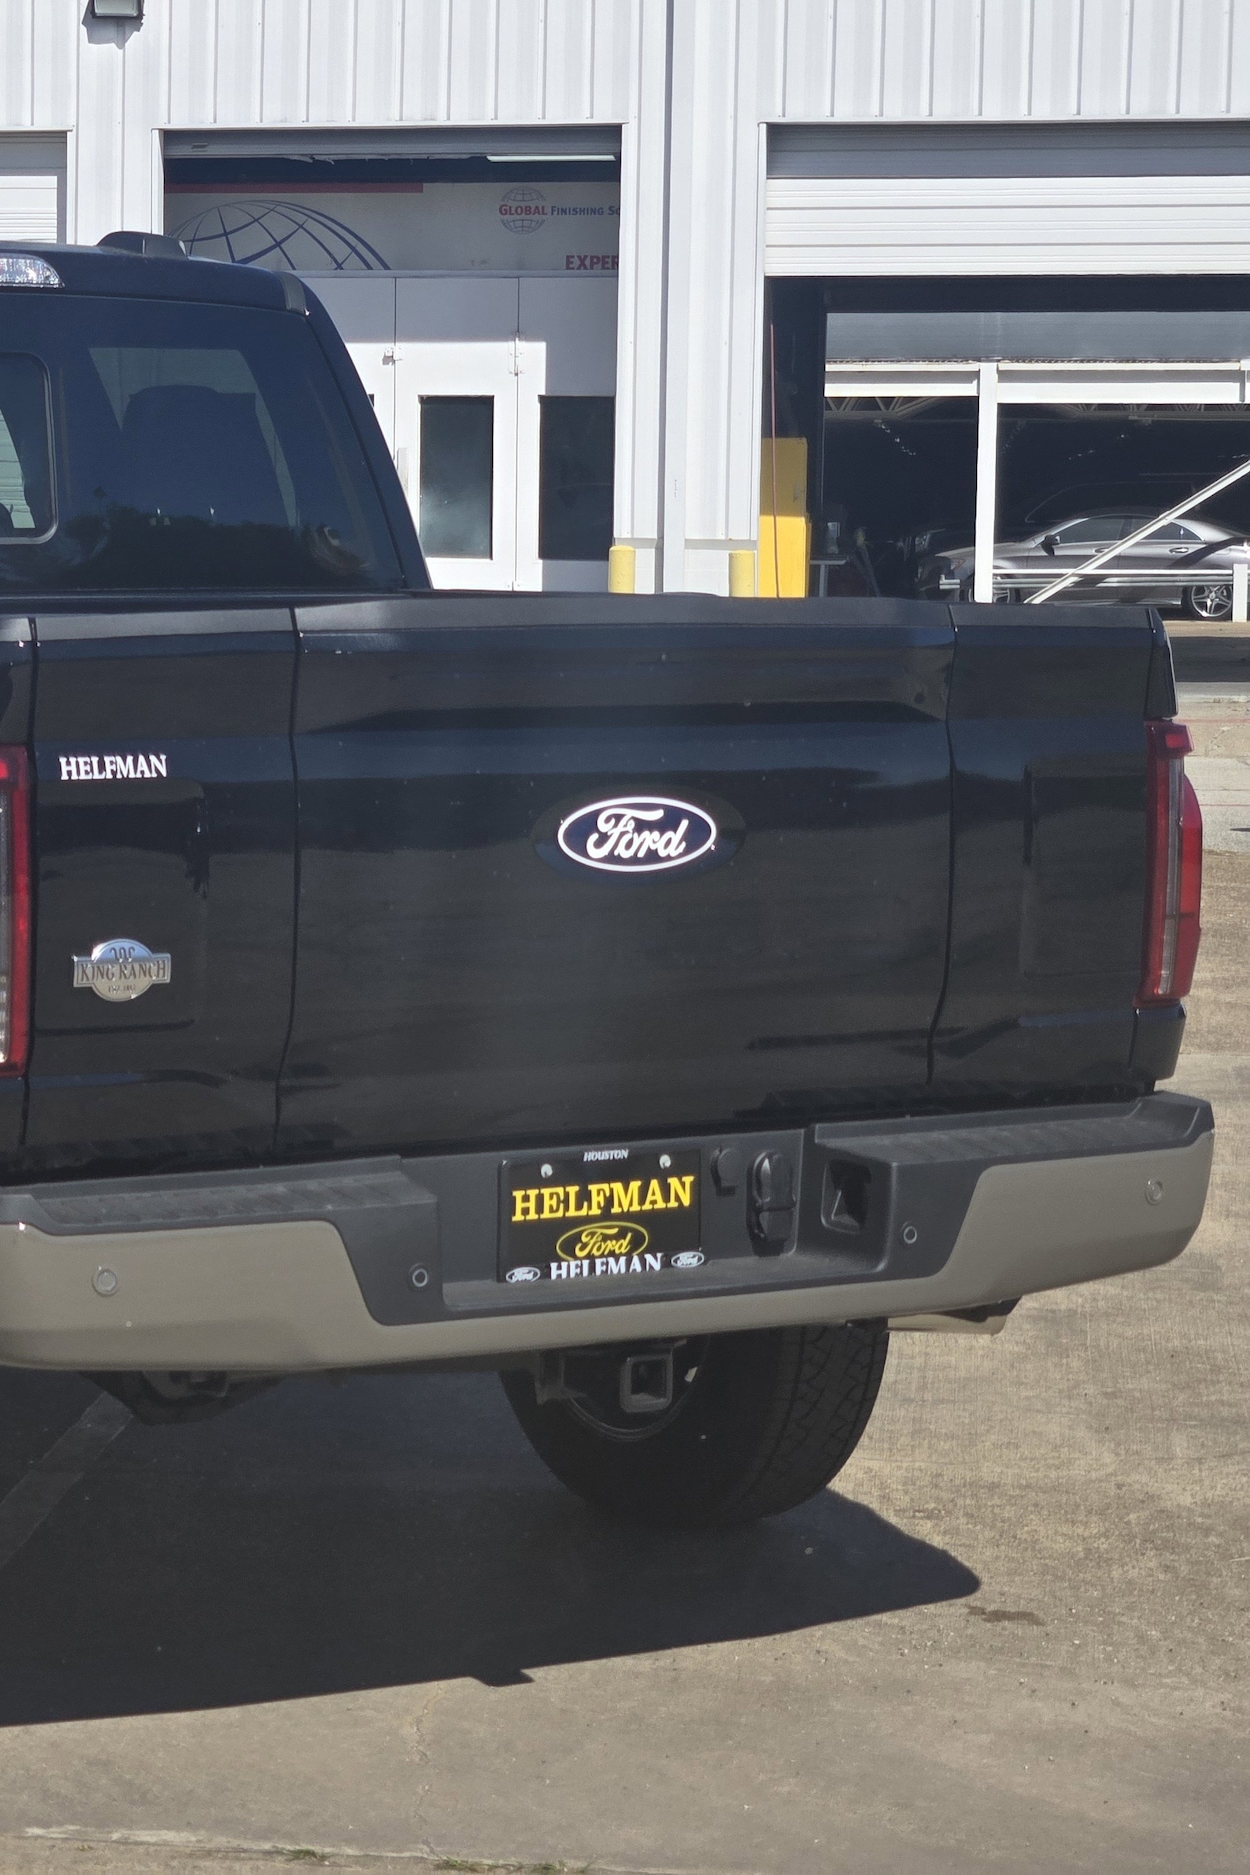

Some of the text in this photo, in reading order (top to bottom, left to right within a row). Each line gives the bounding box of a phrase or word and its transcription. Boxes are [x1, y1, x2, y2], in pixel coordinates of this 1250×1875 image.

[498, 204, 548, 216] GLOBAL
[550, 205, 605, 216] FINISHING
[58, 754, 168, 781] HELFMAN
[586, 807, 689, 859] Ford
[80, 959, 167, 982] KING RANCH
[583, 1148, 630, 1162] HOUSTON
[511, 1175, 695, 1222] HELFMAN
[549, 1252, 664, 1281] HELFMAN
